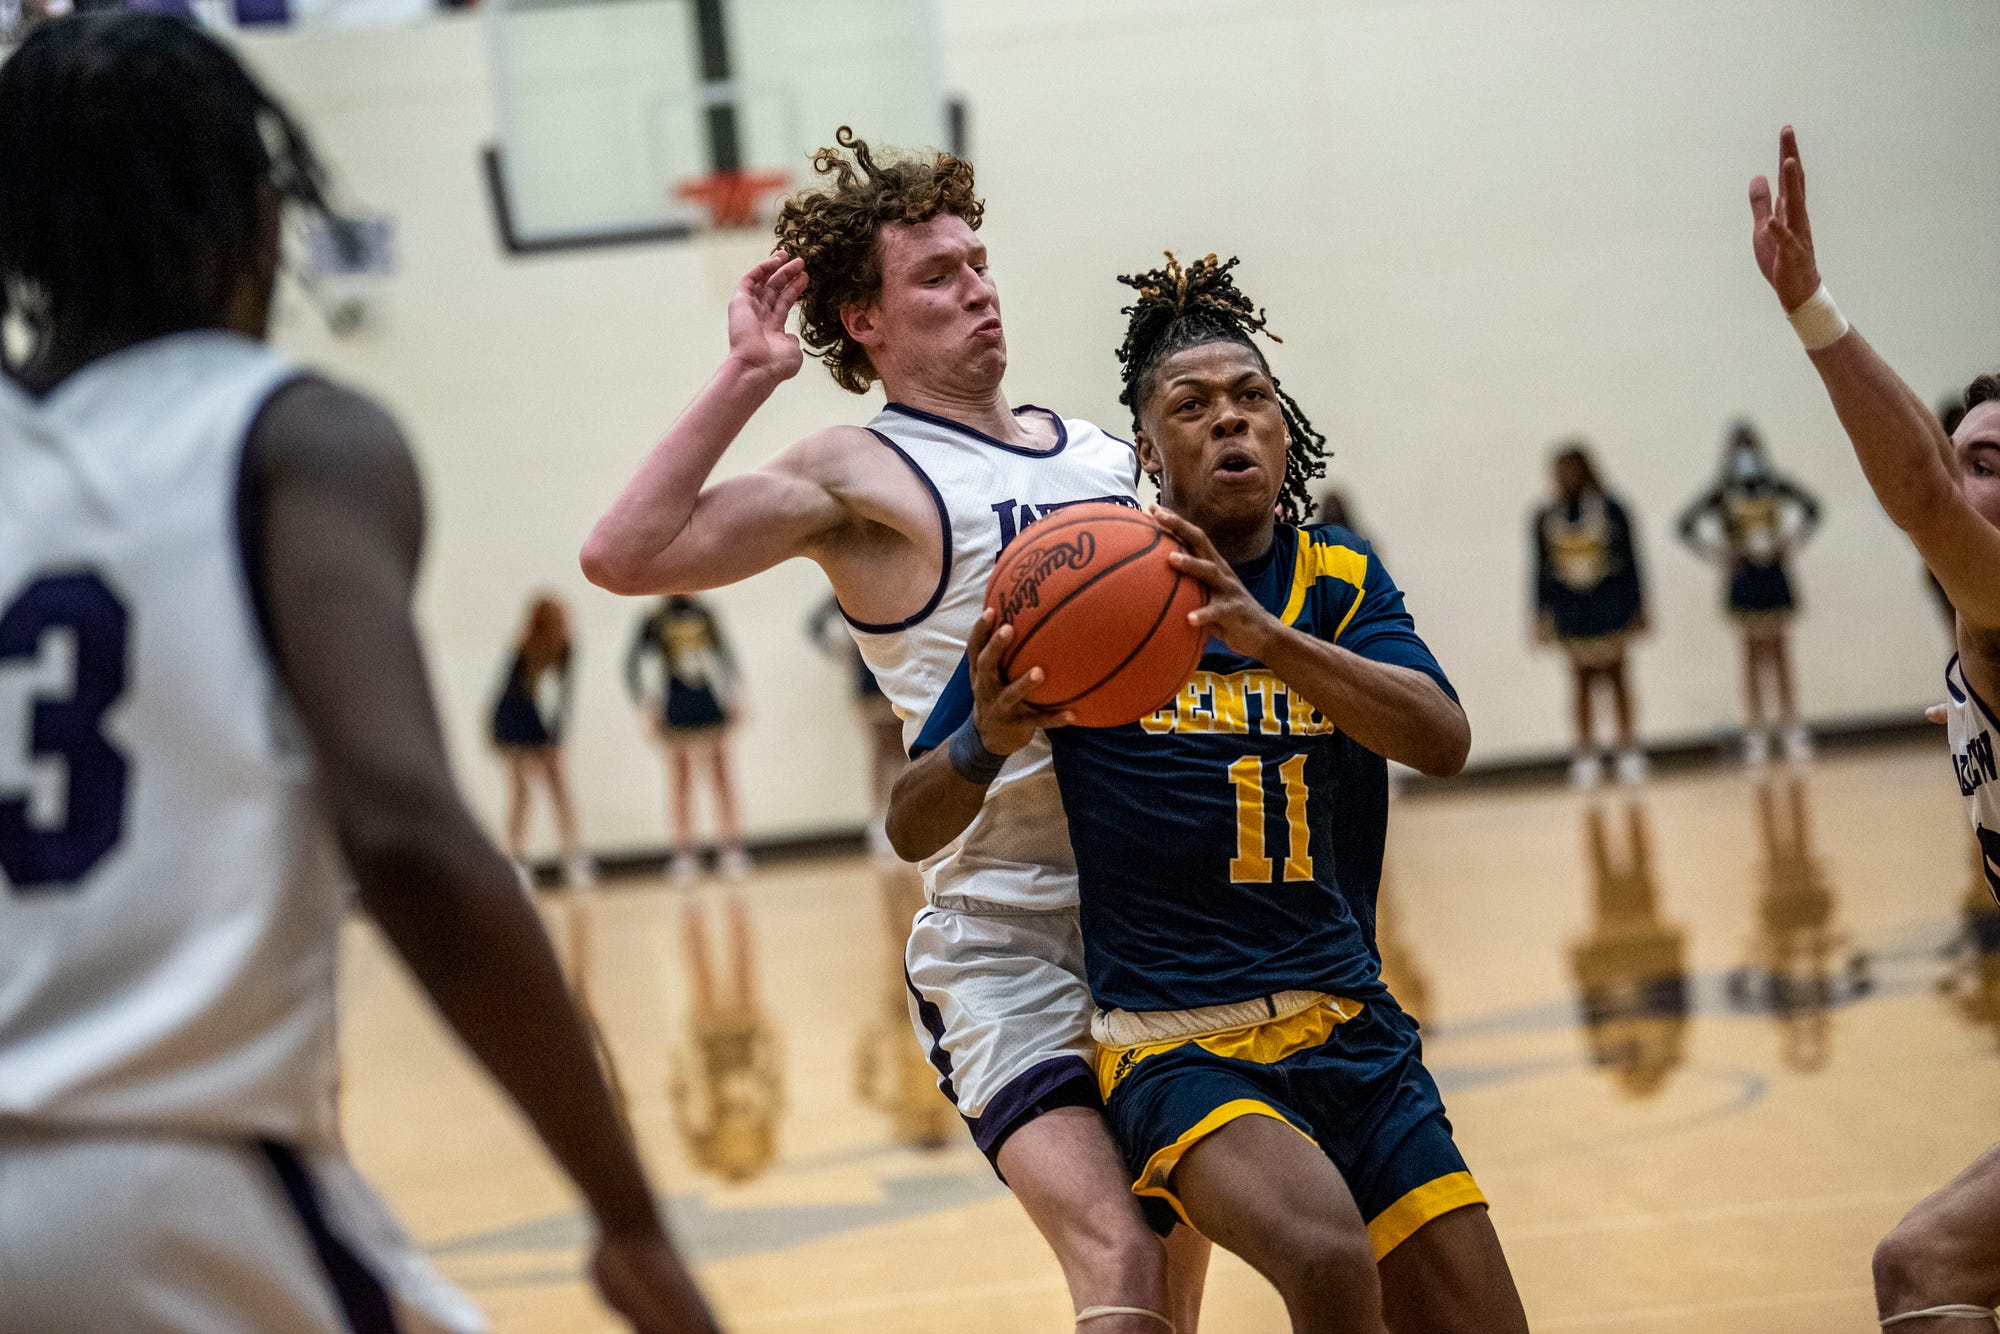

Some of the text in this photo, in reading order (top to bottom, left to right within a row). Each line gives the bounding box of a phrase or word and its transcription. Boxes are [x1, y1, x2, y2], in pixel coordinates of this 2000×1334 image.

[999, 531, 1096, 625] Rawling
[0, 570, 131, 889] 3
[1140, 669, 1335, 736] ENTR
[1228, 754, 1314, 884] 11
